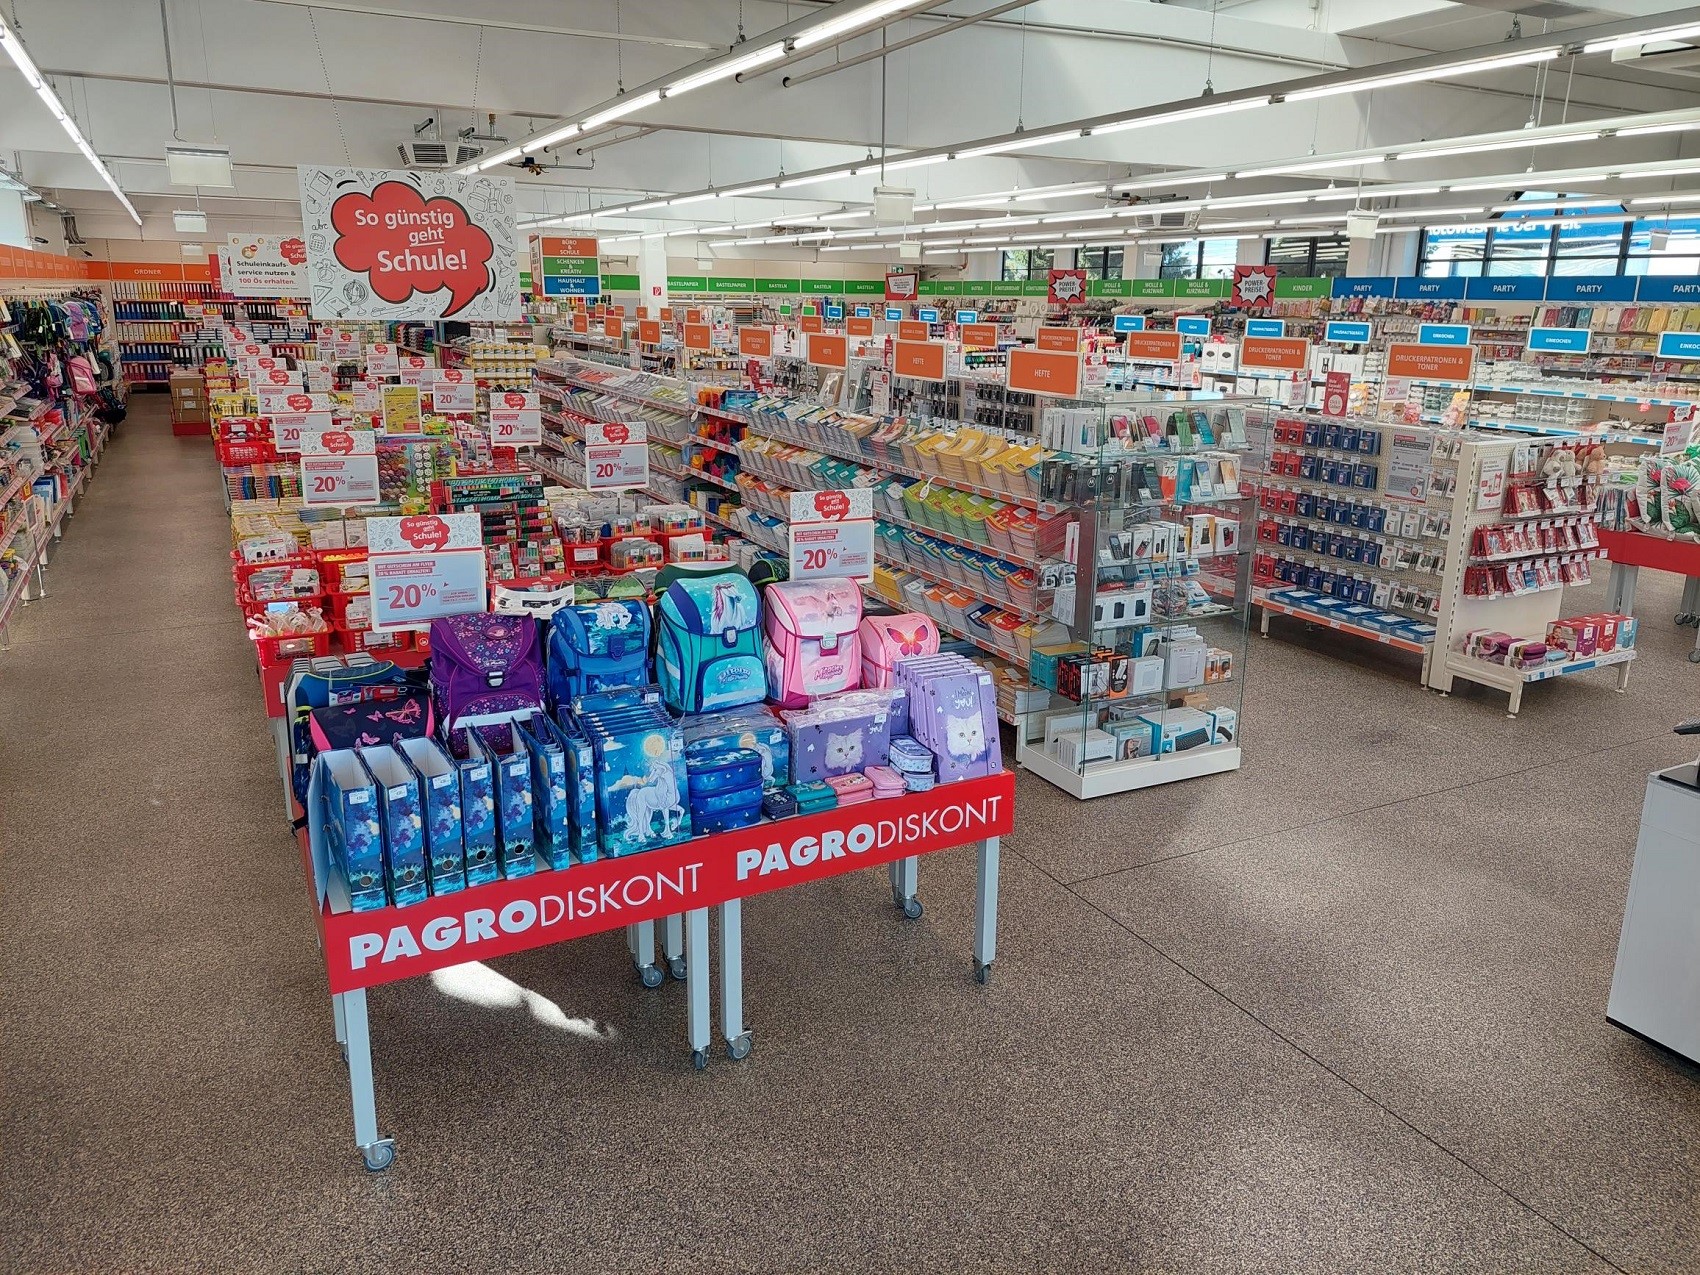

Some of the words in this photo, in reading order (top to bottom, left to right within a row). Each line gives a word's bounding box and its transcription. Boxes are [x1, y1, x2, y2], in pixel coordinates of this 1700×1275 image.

[354, 209, 378, 226] So
[384, 208, 455, 228] günstig
[409, 227, 444, 245] geht
[377, 249, 468, 272] Schule!
[1248, 346, 1294, 355] DRUCKERPATRONEN
[912, 357, 924, 366] HEFTE
[1395, 354, 1457, 364] DRUCKERPATRONEN
[1034, 369, 1050, 378] HEFTE
[494, 425, 519, 436] -20%
[591, 463, 621, 478] -20%
[308, 476, 345, 492] -20%
[413, 531, 442, 540] Schule!
[796, 548, 838, 570] -20%
[379, 583, 436, 609] -20%
[955, 696, 973, 709] you!
[736, 796, 1002, 882] PAGRODISKONT
[348, 864, 704, 971] PAGRODISKONT
